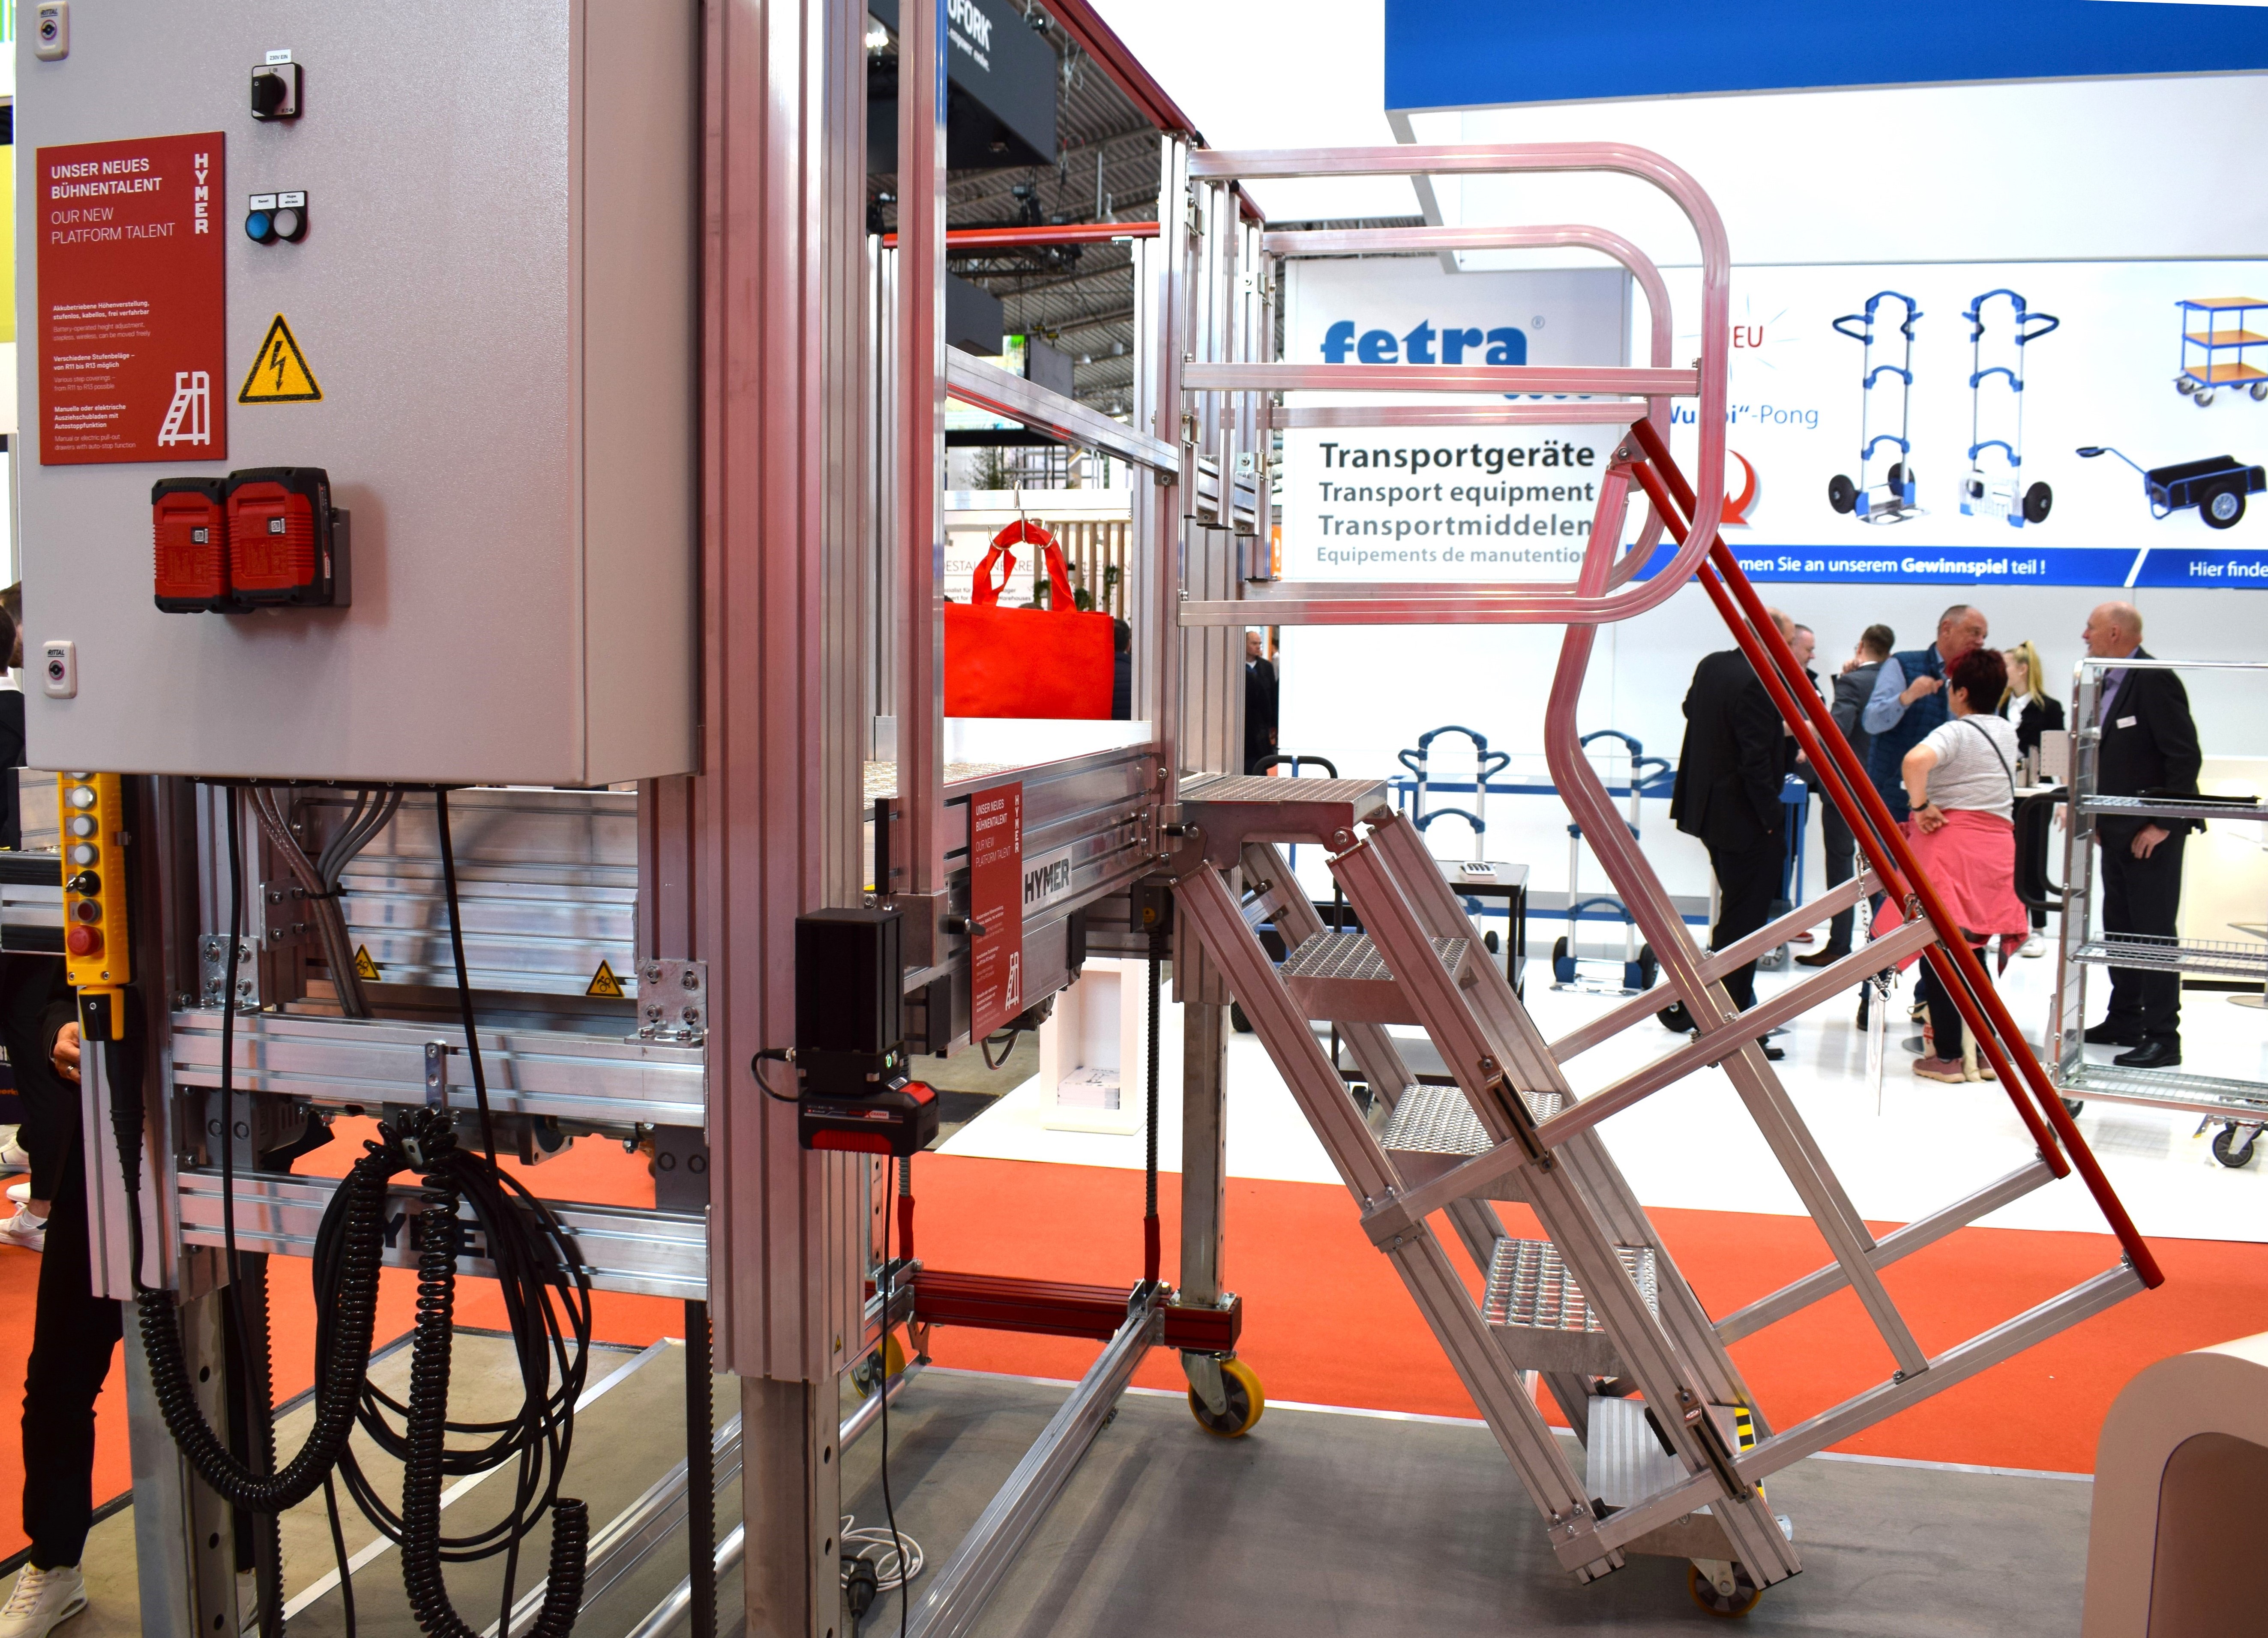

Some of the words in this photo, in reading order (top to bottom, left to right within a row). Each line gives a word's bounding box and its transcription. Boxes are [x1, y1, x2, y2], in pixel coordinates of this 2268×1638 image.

[51, 163, 98, 179] UNSER
[103, 159, 150, 175] NEUES
[52, 178, 162, 199] BÜHNENTALENT
[195, 153, 208, 234] HYMER
[51, 210, 79, 224] OUR
[84, 207, 113, 222] NEW
[52, 228, 121, 244] PLATFORM
[126, 223, 175, 238] TALENT
[54, 324, 96, 332] Battery-operated
[1729, 325, 1764, 348] EU
[1320, 319, 1527, 365] fetra
[1319, 440, 1595, 474] Transportgeräte
[1319, 482, 1442, 506] Transport
[1450, 481, 1594, 506] equipment
[1318, 514, 1592, 540] Transportmiddelen
[1317, 547, 1437, 565] Equipements
[1443, 547, 1465, 562] de
[1777, 556, 1801, 572] Sie
[1804, 560, 1825, 572] an
[1828, 560, 1897, 572] unserem
[1901, 557, 2007, 577] Gewinnspiel
[2011, 559, 2036, 574] teil
[2190, 561, 2224, 577] Hier
[2227, 560, 2268, 577] finde
[976, 803, 990, 815] UNSER
[991, 799, 1004, 812] NEUES
[976, 813, 1007, 832] BÜHNENTALENT
[976, 840, 984, 852] OUR
[985, 836, 995, 848] NEW
[976, 851, 996, 868] PLATFORM
[997, 846, 1011, 859] TALENT
[1025, 858, 1069, 904] HYMER
